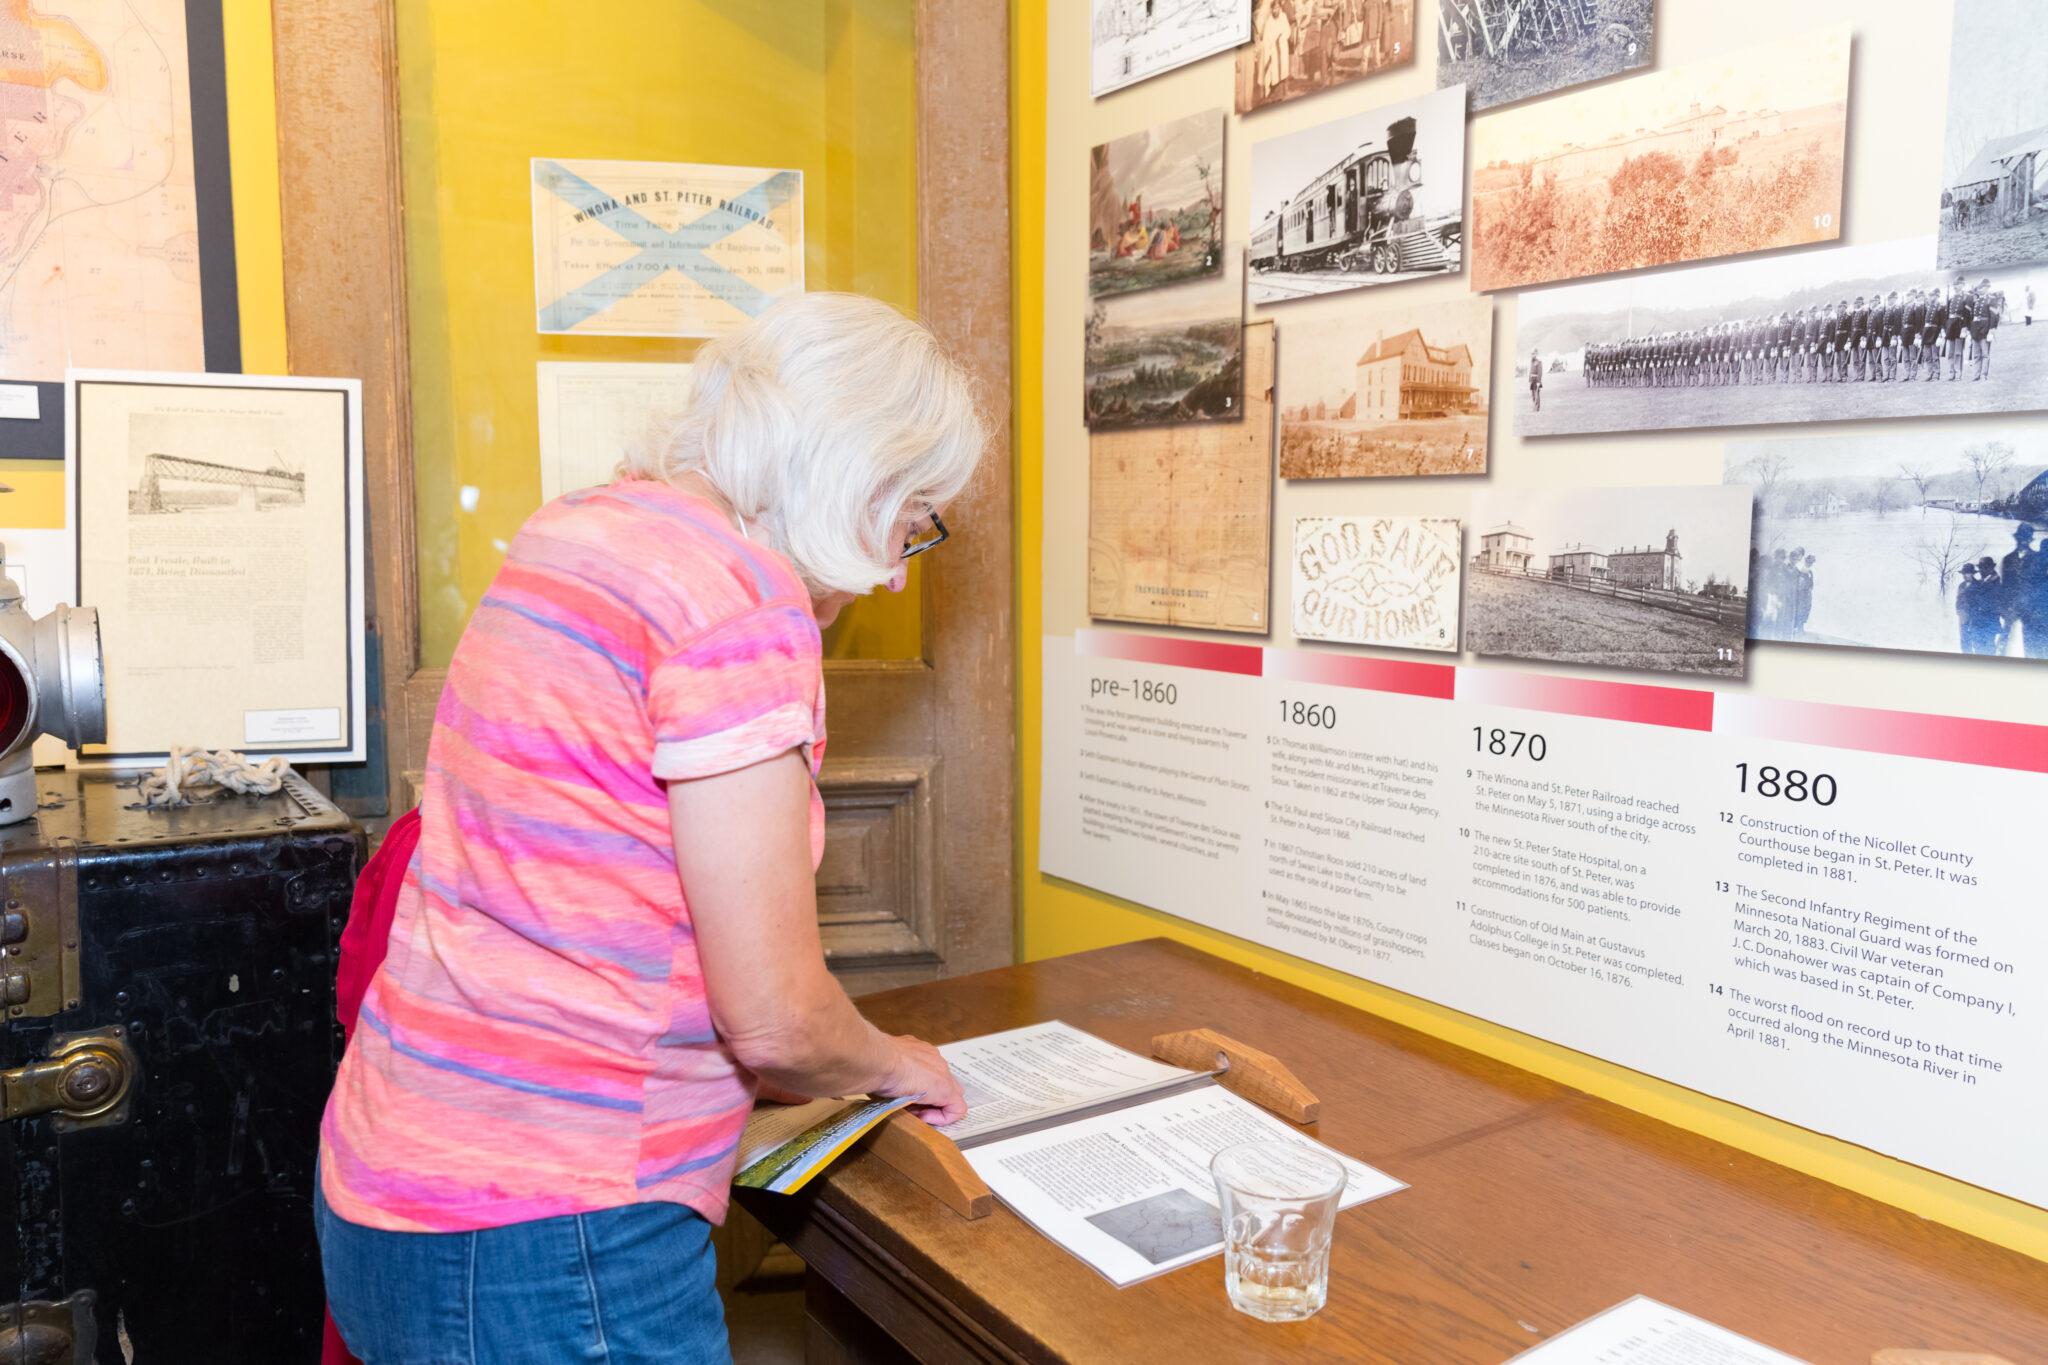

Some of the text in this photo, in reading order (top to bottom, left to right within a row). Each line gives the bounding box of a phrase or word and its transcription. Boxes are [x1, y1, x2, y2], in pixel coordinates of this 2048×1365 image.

[1393, 42, 1401, 55] 5
[1628, 42, 1637, 56] 9
[573, 199, 619, 224] WINONA
[625, 193, 648, 207] AND
[654, 191, 672, 202] ST.
[677, 191, 712, 207] PETER
[719, 200, 775, 230] RAILROAD
[1812, 214, 1832, 228] 10
[1363, 594, 1441, 641] HOME
[1439, 629, 1445, 638] 8
[1717, 648, 1732, 660] 11
[1279, 699, 1336, 729] 1860
[1472, 725, 1547, 761] 1870
[1466, 769, 1472, 778] 9
[1476, 769, 1493, 782] The
[1493, 773, 1529, 788] Winona
[1530, 781, 1549, 792] and
[1564, 784, 1590, 798] Peter
[1591, 788, 1634, 806] Railroad
[1635, 798, 1680, 814] reached
[1735, 762, 1837, 806] 1880
[1474, 800, 1490, 812] the
[1491, 802, 1540, 821] Minnesota
[1540, 812, 1565, 826] River
[1566, 819, 1596, 832] south
[1597, 823, 1608, 834] of
[1609, 825, 1628, 838] the
[1487, 786, 1510, 800] Peter
[1512, 793, 1525, 803] on
[1526, 794, 1546, 809] May
[1586, 806, 1614, 822] using
[1615, 812, 1622, 821] a
[1624, 810, 1659, 829] bridge
[1661, 820, 1696, 835] across
[1459, 828, 1470, 838] 10
[1474, 829, 1490, 842] The
[1491, 835, 1511, 847] new
[1525, 840, 1550, 854] Peter
[1551, 845, 1576, 860] State
[1623, 862, 1638, 873] on
[1639, 866, 1647, 875] a
[1719, 812, 1973, 868] 12 Construction of the Nicollet County
[1738, 831, 1977, 886] Courthouse began in St. Peter. It was
[1472, 844, 1511, 862] 210-acre
[1512, 854, 1529, 866] site
[1530, 859, 1558, 872] south
[1559, 863, 1570, 875] of
[1614, 877, 1635, 889] was
[1472, 861, 1520, 879] completed
[1521, 870, 1531, 882] in
[1559, 881, 1579, 893] and
[1580, 886, 1600, 898] was
[1601, 889, 1624, 904] able
[1625, 895, 1637, 906] to
[1638, 899, 1681, 917] provide
[1737, 851, 1856, 883] completed in 1881.
[1471, 876, 1549, 902] accommodations
[1550, 892, 1565, 905] for
[1566, 896, 1585, 911] 500
[1715, 881, 1977, 946] 13 The Second Infantry Regiment of the
[1456, 901, 1645, 958] 11 Construction of Old Main at Gustavus
[1469, 918, 1512, 939] Adolphus
[1513, 930, 1549, 949] College
[1550, 939, 1560, 951] in
[1574, 946, 1601, 962] Peter
[1602, 956, 1623, 969] was
[1733, 918, 1943, 978] March 20, 1883. Civil War veteran
[1734, 901, 2014, 974] Minnesota National Guard was formed on
[1468, 932, 1500, 951] Classes
[1501, 942, 1531, 959] began
[1532, 953, 1546, 963] on
[1546, 954, 1587, 975] October
[1734, 955, 1914, 1010] which was based in St. Peter.
[1755, 941, 1828, 969] Donahower
[1831, 962, 1856, 976] was
[1860, 969, 1911, 990] captain
[1914, 981, 1930, 994] of
[1932, 984, 2004, 1014] Company
[2007, 1001, 2017, 1017] I,
[1708, 984, 2002, 1072] 14 The worst flood on record up to that time
[1726, 1022, 1789, 1051] April 1881.
[1727, 1007, 1976, 1085] occurred along the Minnesota River in
